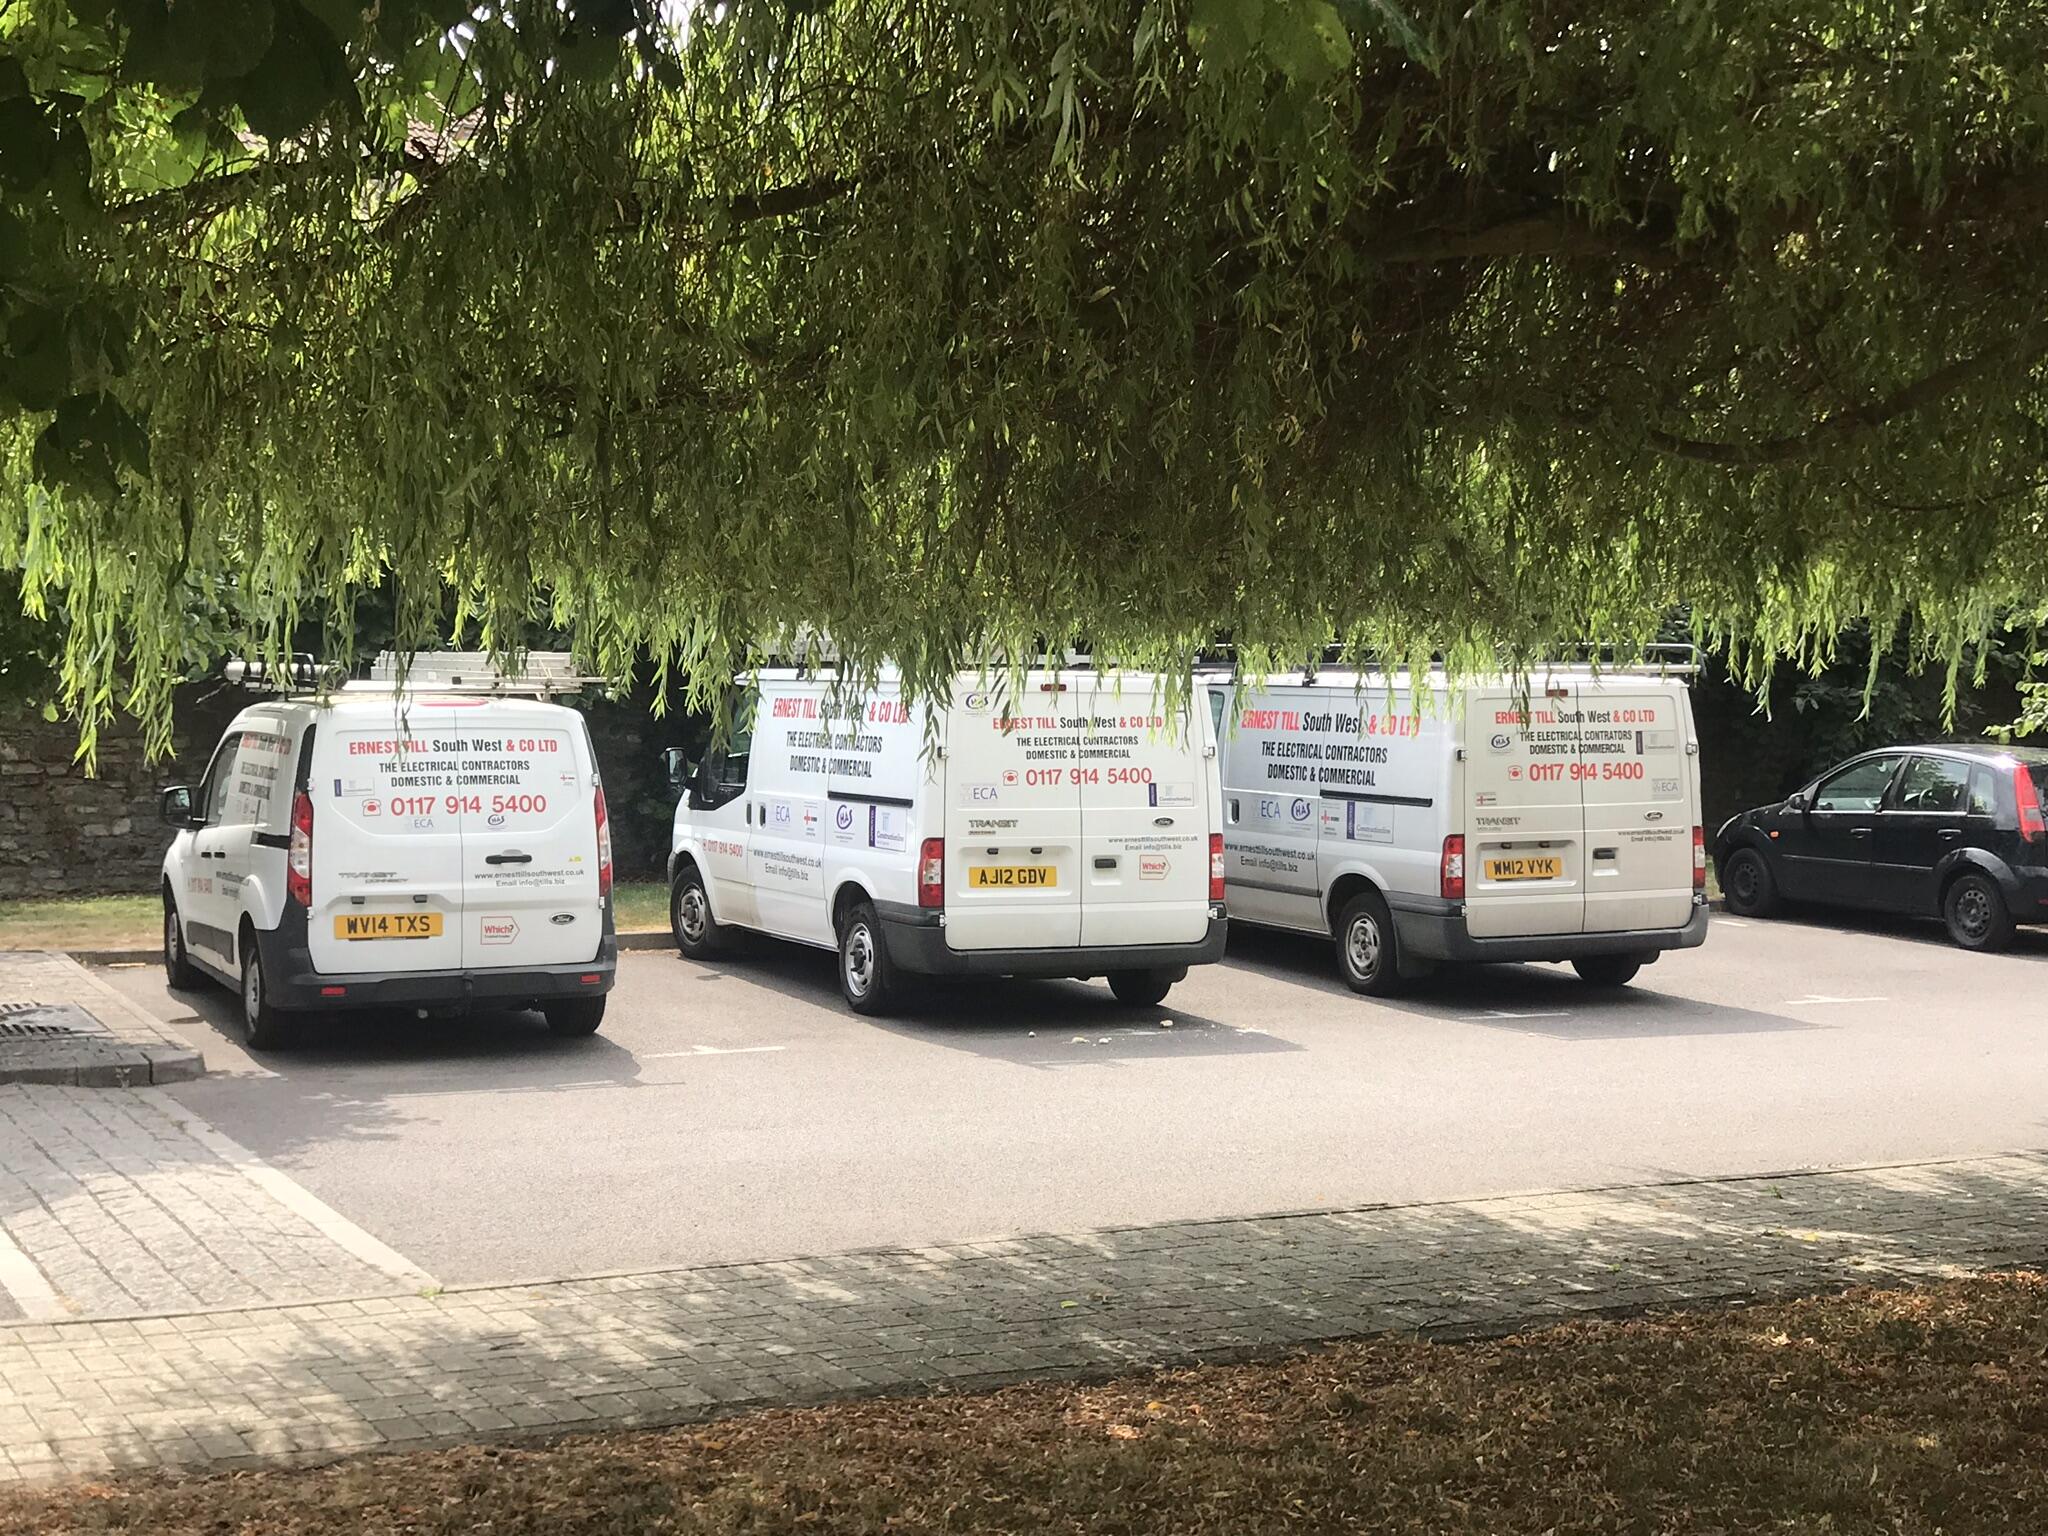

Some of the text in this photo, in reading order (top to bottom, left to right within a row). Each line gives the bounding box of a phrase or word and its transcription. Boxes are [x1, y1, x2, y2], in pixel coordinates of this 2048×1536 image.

[773, 698, 802, 718] ERNEST
[803, 698, 817, 719] TILL
[869, 701, 876, 722] &
[878, 701, 892, 722] CO
[1495, 710, 1655, 724] ERNET TILL South West & CO LTD
[1036, 717, 1057, 728] TILL
[1060, 717, 1088, 728] South
[1093, 717, 1116, 728] West
[1119, 717, 1126, 728] &
[1130, 716, 1143, 728] CO
[1241, 710, 1280, 729] ERNEST
[1281, 711, 1299, 731] TILL
[1302, 712, 1332, 732] South
[1335, 713, 1362, 733] West
[1368, 715, 1377, 735] &
[786, 731, 797, 747] THE
[835, 733, 882, 753] CONTRACTORS
[1017, 736, 1139, 746] THE ELECTRICAL CONTRACTORS
[1520, 732, 1535, 742] THE
[1537, 731, 1583, 741] ELECTRICAL
[349, 740, 400, 755] ERNEST
[433, 739, 468, 752] South
[472, 738, 502, 752] West
[506, 739, 515, 752] &
[519, 739, 535, 752] CO
[538, 739, 557, 753] LTD
[1262, 741, 1388, 763] THE ELECTRICAL CONTRACTORS
[1529, 744, 1626, 754] DOMESTIC & COMMERCIAL
[1026, 749, 1131, 760] DOMESTIC & COMMERCIAL
[379, 760, 530, 773] THE ELECTRICAL CONTRACTORS
[790, 755, 821, 773] DOMESTIC
[828, 758, 872, 778] COMMERCIAL
[1529, 762, 1644, 781] 0117 914 5400
[391, 775, 521, 787] DOMESTIC & COMMERCIAL
[1026, 767, 1152, 786] 0117 914 5400
[1268, 763, 1376, 786] DOMESTIC & COMMERCIAL
[973, 788, 998, 800] ECA
[1661, 782, 1679, 791] ECA
[391, 794, 547, 816] 0117 914 5400
[1261, 800, 1280, 818] ECA
[775, 805, 791, 822] ECA
[414, 819, 434, 829] ECA
[969, 820, 1019, 828] TRANSIT
[474, 868, 584, 879] www.ernesttillsouthwest.co.uk
[1493, 860, 1553, 875] WM12 VYK
[979, 868, 1047, 885] AJ12 GDV
[347, 915, 431, 934] WV14 TXS
[484, 924, 514, 934] Which?
